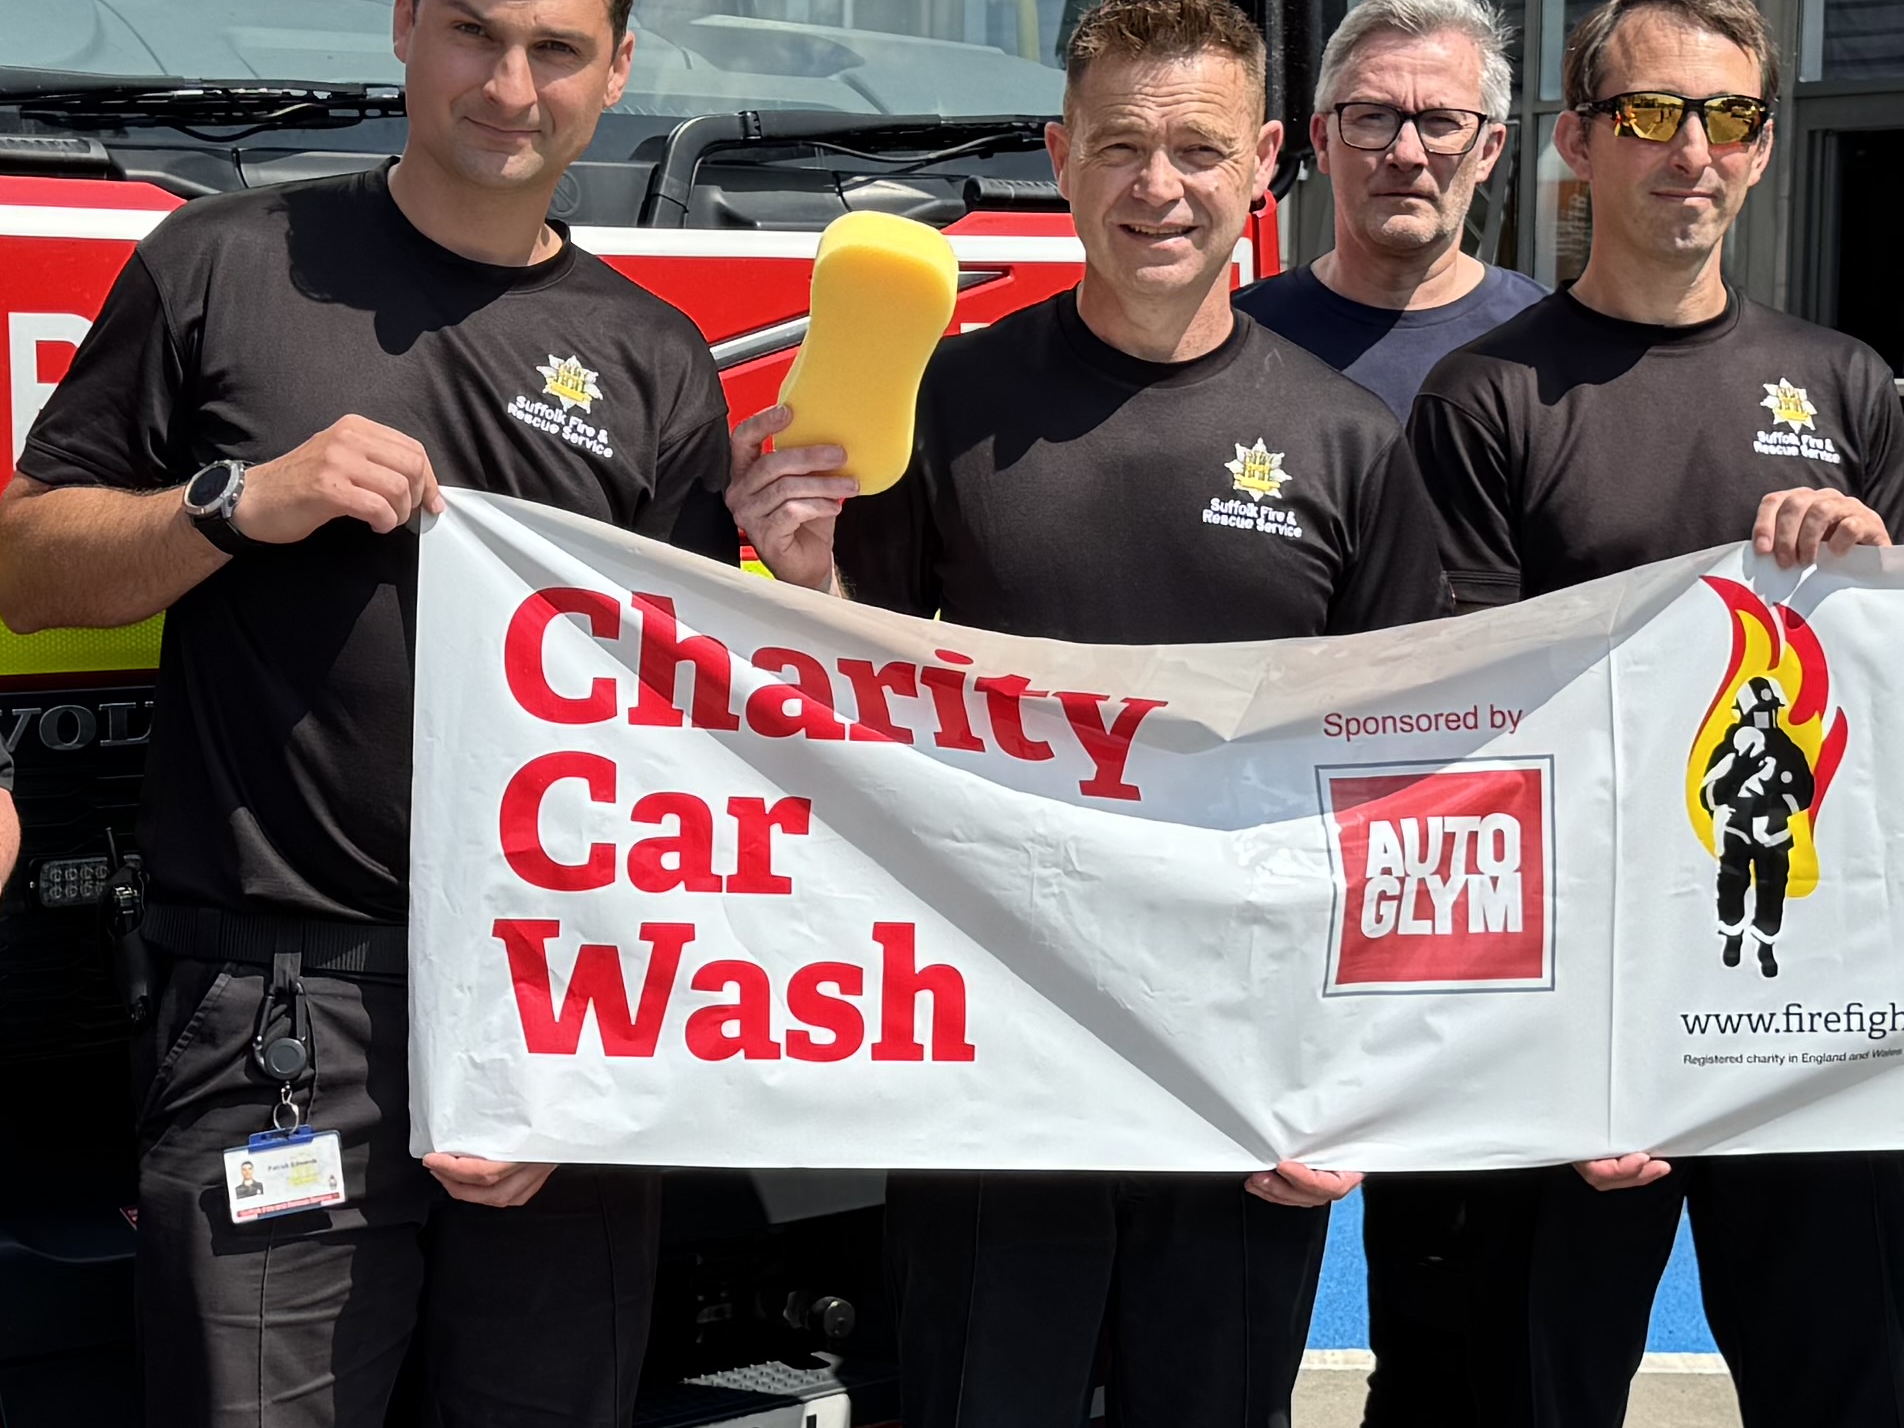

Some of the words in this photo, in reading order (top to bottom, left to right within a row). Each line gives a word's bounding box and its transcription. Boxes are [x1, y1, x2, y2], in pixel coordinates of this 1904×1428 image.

[508, 402, 559, 434] Rescue
[562, 424, 613, 458] Service
[516, 396, 566, 425] Suffolk
[569, 416, 596, 438] Fire
[598, 429, 609, 444] &
[1757, 431, 1800, 447] Suffolk
[1202, 509, 1253, 529] Rescue
[1256, 518, 1302, 538] Service
[1211, 498, 1258, 519] Suffolk
[1260, 506, 1285, 522] Fire
[1286, 511, 1297, 526] &
[503, 586, 1166, 800] Charity
[1323, 705, 1479, 742] Sponsored
[1490, 704, 1523, 734] by
[499, 751, 812, 895] Car
[1365, 813, 1522, 877] AUTO
[1360, 872, 1524, 939] GLYM
[492, 918, 976, 1063] Wash
[1684, 1054, 1743, 1067] Registered
[1746, 1053, 1786, 1066] charity
[1788, 1053, 1798, 1064] in
[1801, 1052, 1846, 1065] England
[1849, 1052, 1869, 1062] and
